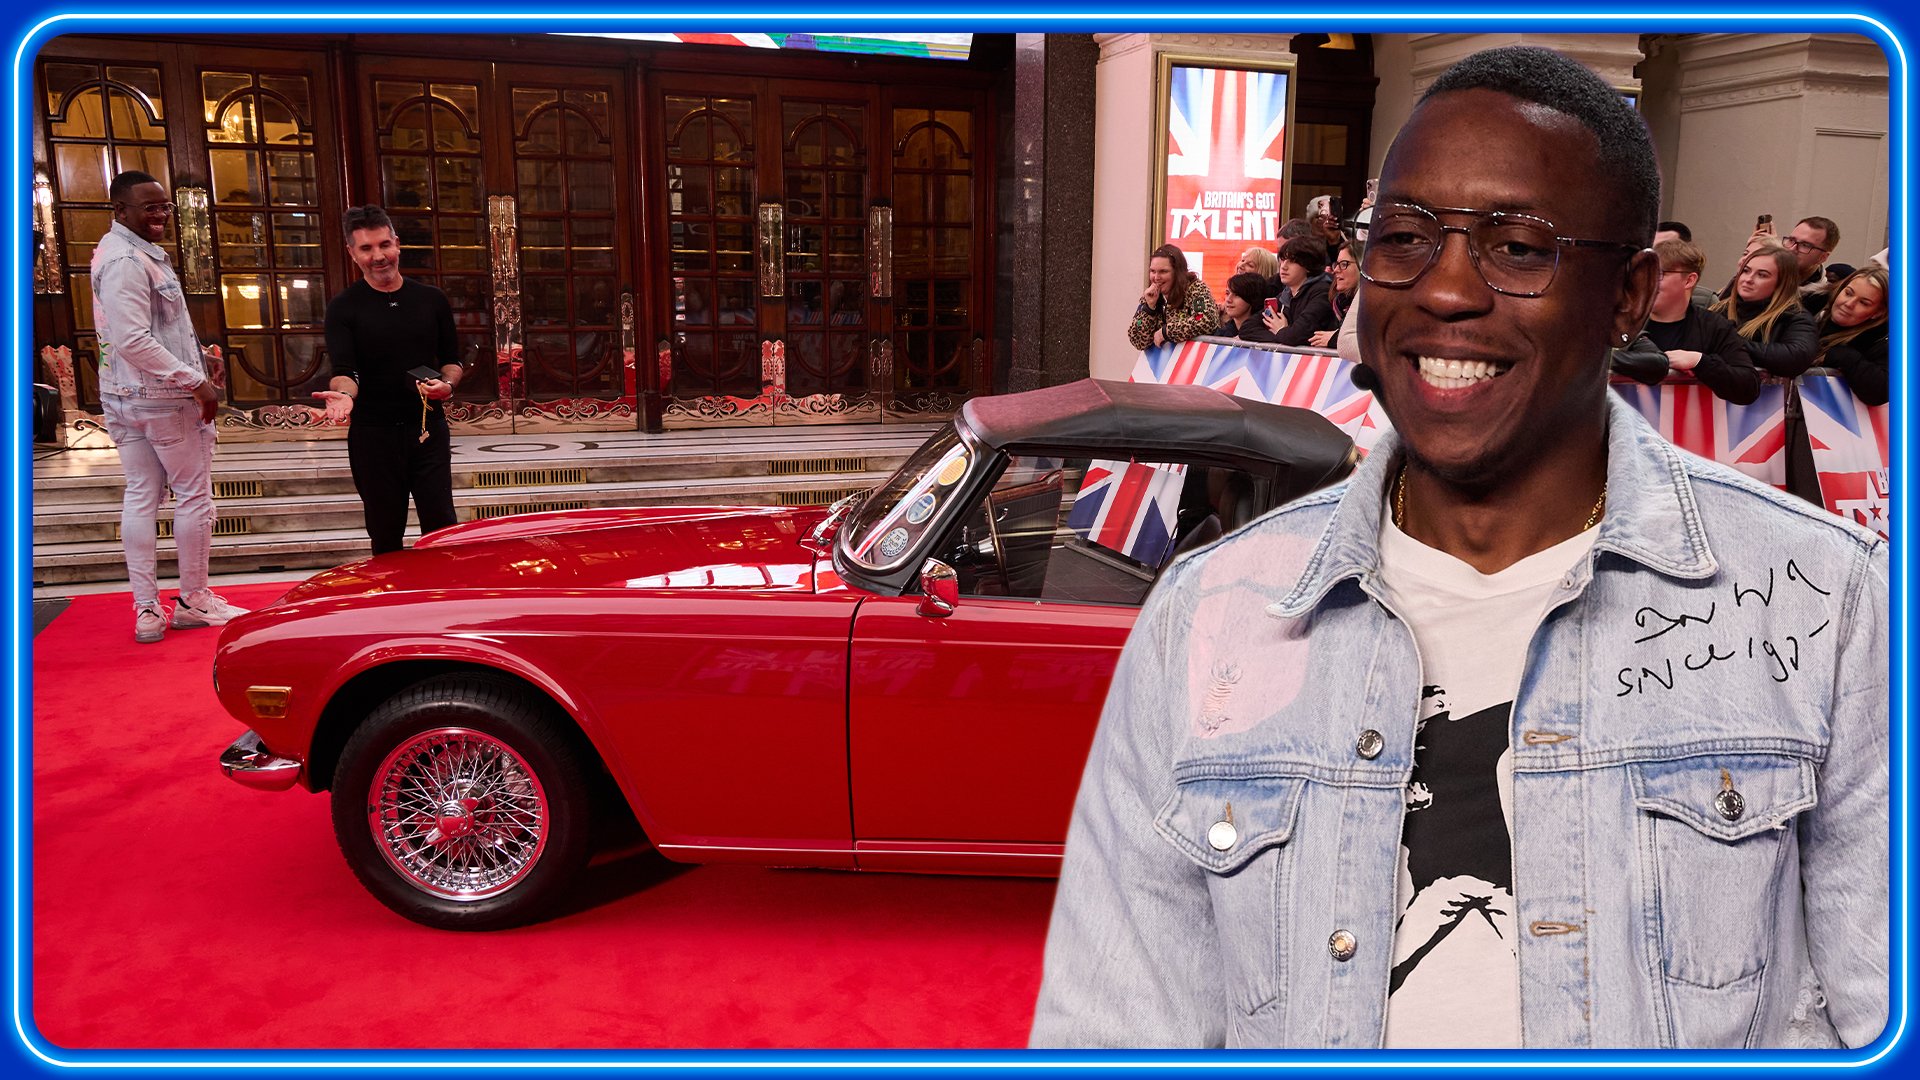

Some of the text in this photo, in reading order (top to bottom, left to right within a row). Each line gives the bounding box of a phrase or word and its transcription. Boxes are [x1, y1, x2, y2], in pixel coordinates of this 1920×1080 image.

[1170, 193, 1278, 240] TALENT
[1203, 190, 1276, 210] BRITAIN'S GOT
